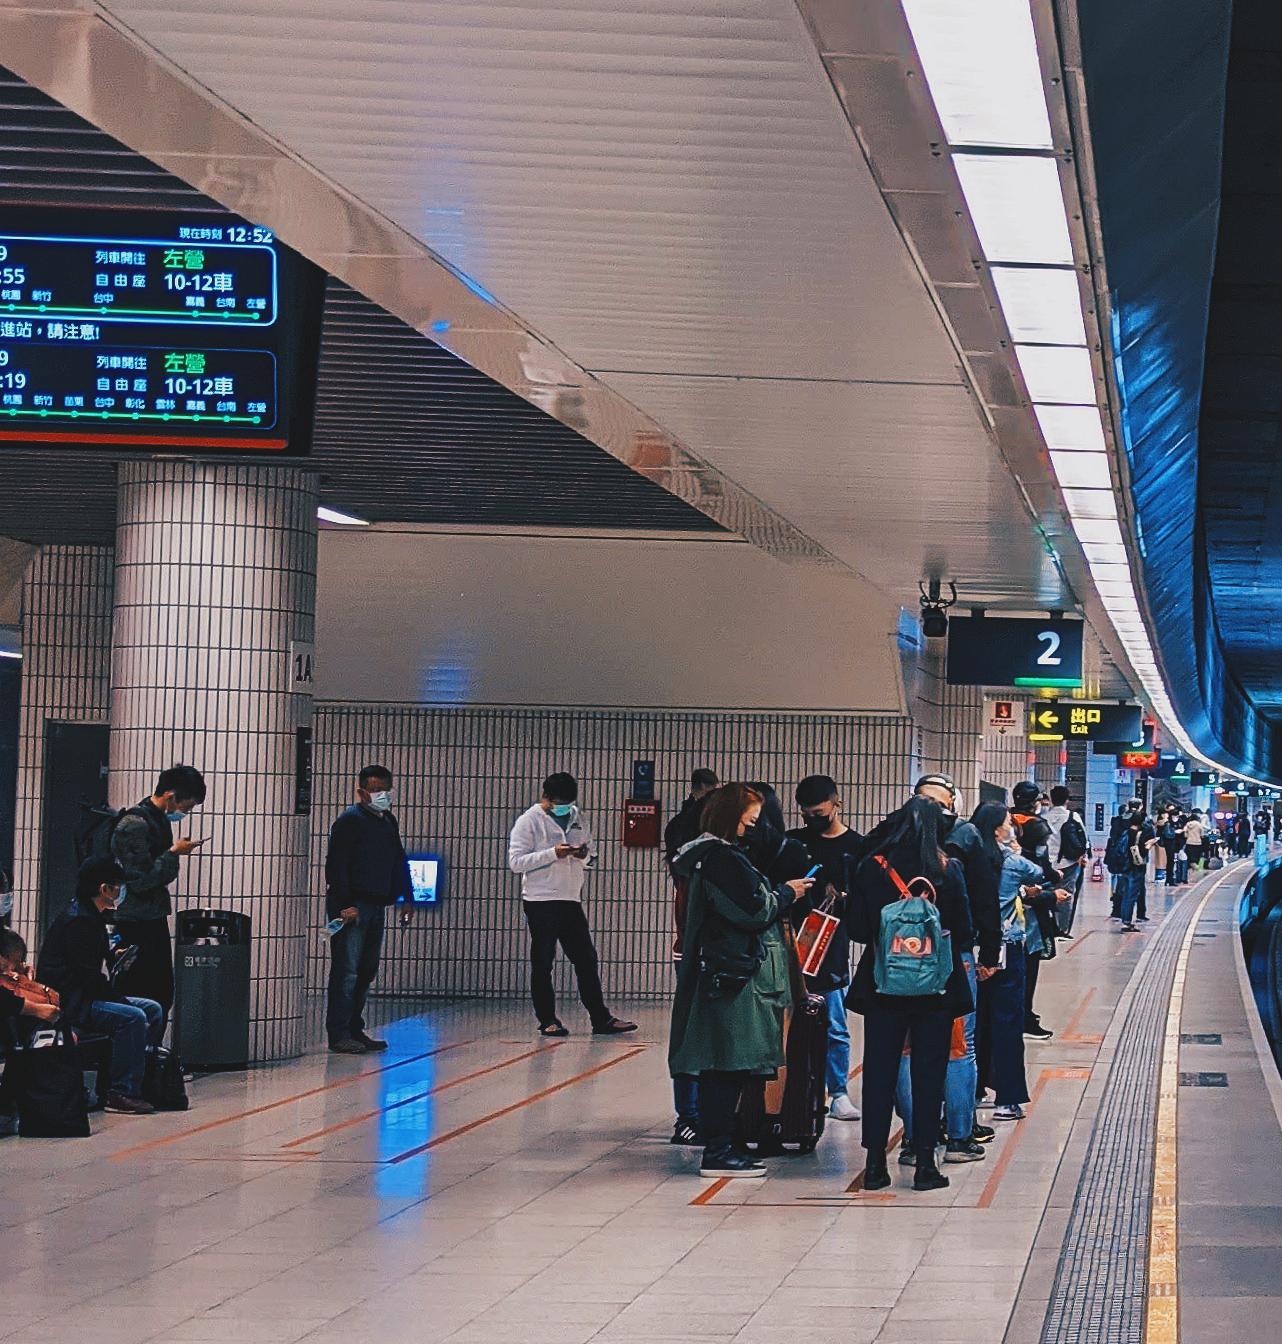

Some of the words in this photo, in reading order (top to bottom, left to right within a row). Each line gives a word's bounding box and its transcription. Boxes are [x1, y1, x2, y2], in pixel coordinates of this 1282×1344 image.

[227, 227, 273, 243] 12:52
[163, 249, 205, 269] 左營
[164, 273, 234, 292] 10-12車
[96, 355, 147, 370] 列車開往
[164, 352, 206, 374] 左營
[165, 377, 234, 396] 10-12車
[1037, 631, 1062, 665] 2
[295, 654, 313, 682] 1A
[1071, 708, 1101, 724] 出口
[1071, 724, 1088, 734] Exit
[1175, 761, 1185, 774] 4
